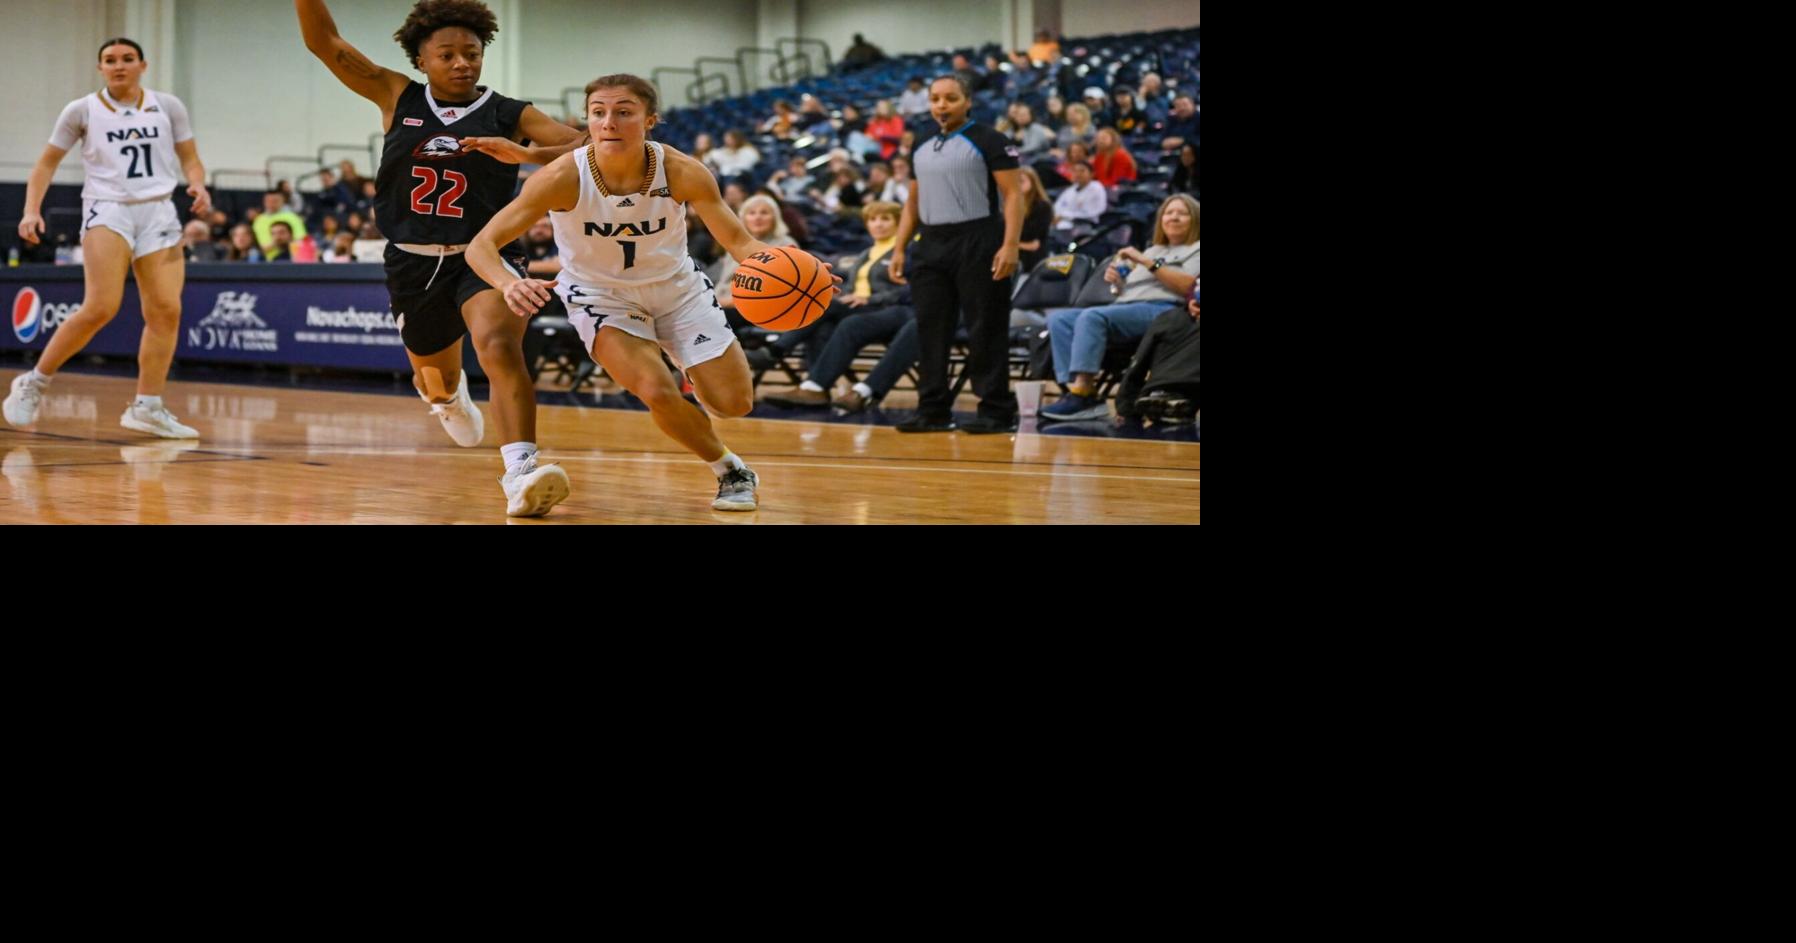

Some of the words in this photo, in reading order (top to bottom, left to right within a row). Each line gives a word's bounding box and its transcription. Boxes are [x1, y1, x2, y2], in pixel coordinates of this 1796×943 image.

[106, 126, 159, 142] NAU
[120, 144, 153, 178] 21
[411, 166, 467, 218] 22
[584, 217, 666, 237] NAU
[616, 240, 635, 269] 1
